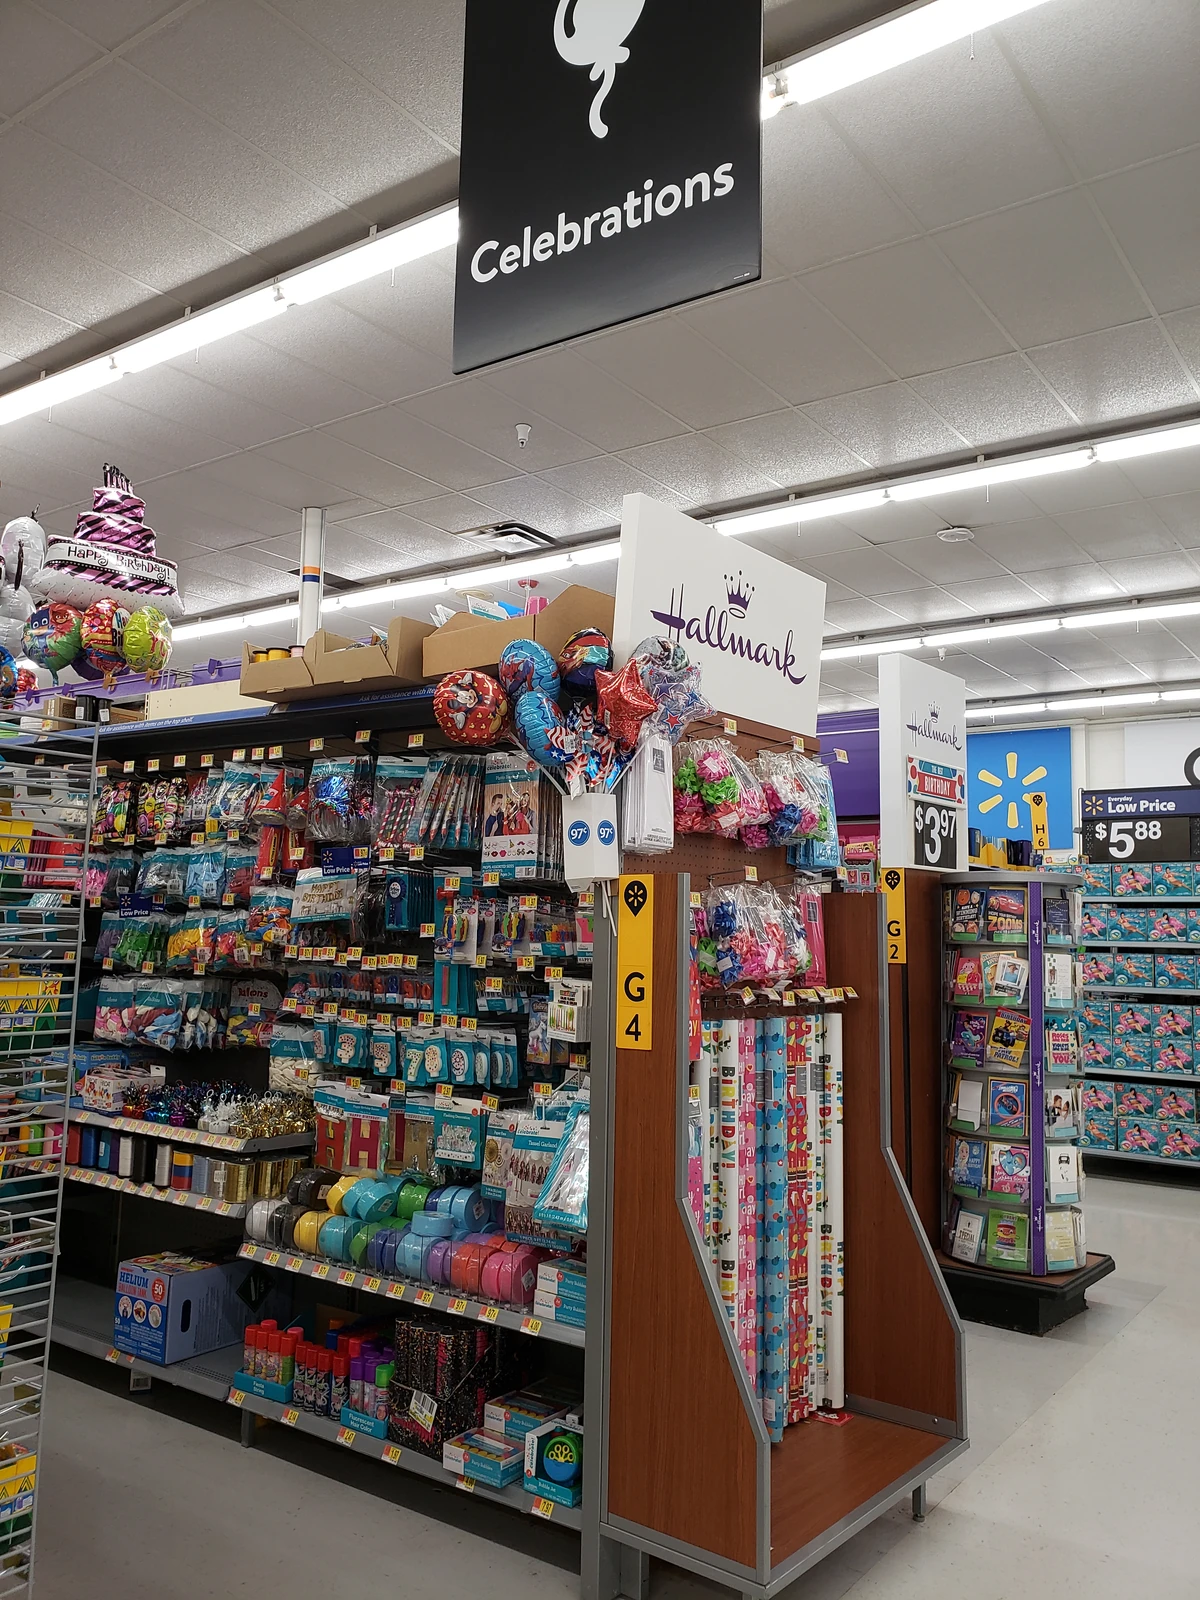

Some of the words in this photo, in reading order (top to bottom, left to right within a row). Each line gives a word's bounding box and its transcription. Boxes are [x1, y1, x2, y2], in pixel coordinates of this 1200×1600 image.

[470, 162, 735, 283] Celebrations
[650, 583, 807, 685] Hallmark
[906, 710, 962, 751] Hallmark
[924, 776, 951, 796] BIRTHDAY
[1108, 802, 1137, 814] Low
[1140, 799, 1176, 812] Price
[570, 828, 588, 840] 97¢
[600, 827, 614, 839] 97¢
[1035, 824, 1045, 834] H
[1038, 838, 1044, 847] 6
[886, 920, 900, 937] G
[988, 916, 1023, 931] ZOOMS
[890, 944, 899, 960] 2
[624, 972, 645, 1002] G
[625, 1014, 642, 1041] 4
[120, 1272, 148, 1288] HELIUM
[154, 1284, 163, 1295] 50
[253, 1387, 264, 1395] String
[349, 1413, 375, 1427] Fluorescent
[360, 1424, 372, 1433] Color
